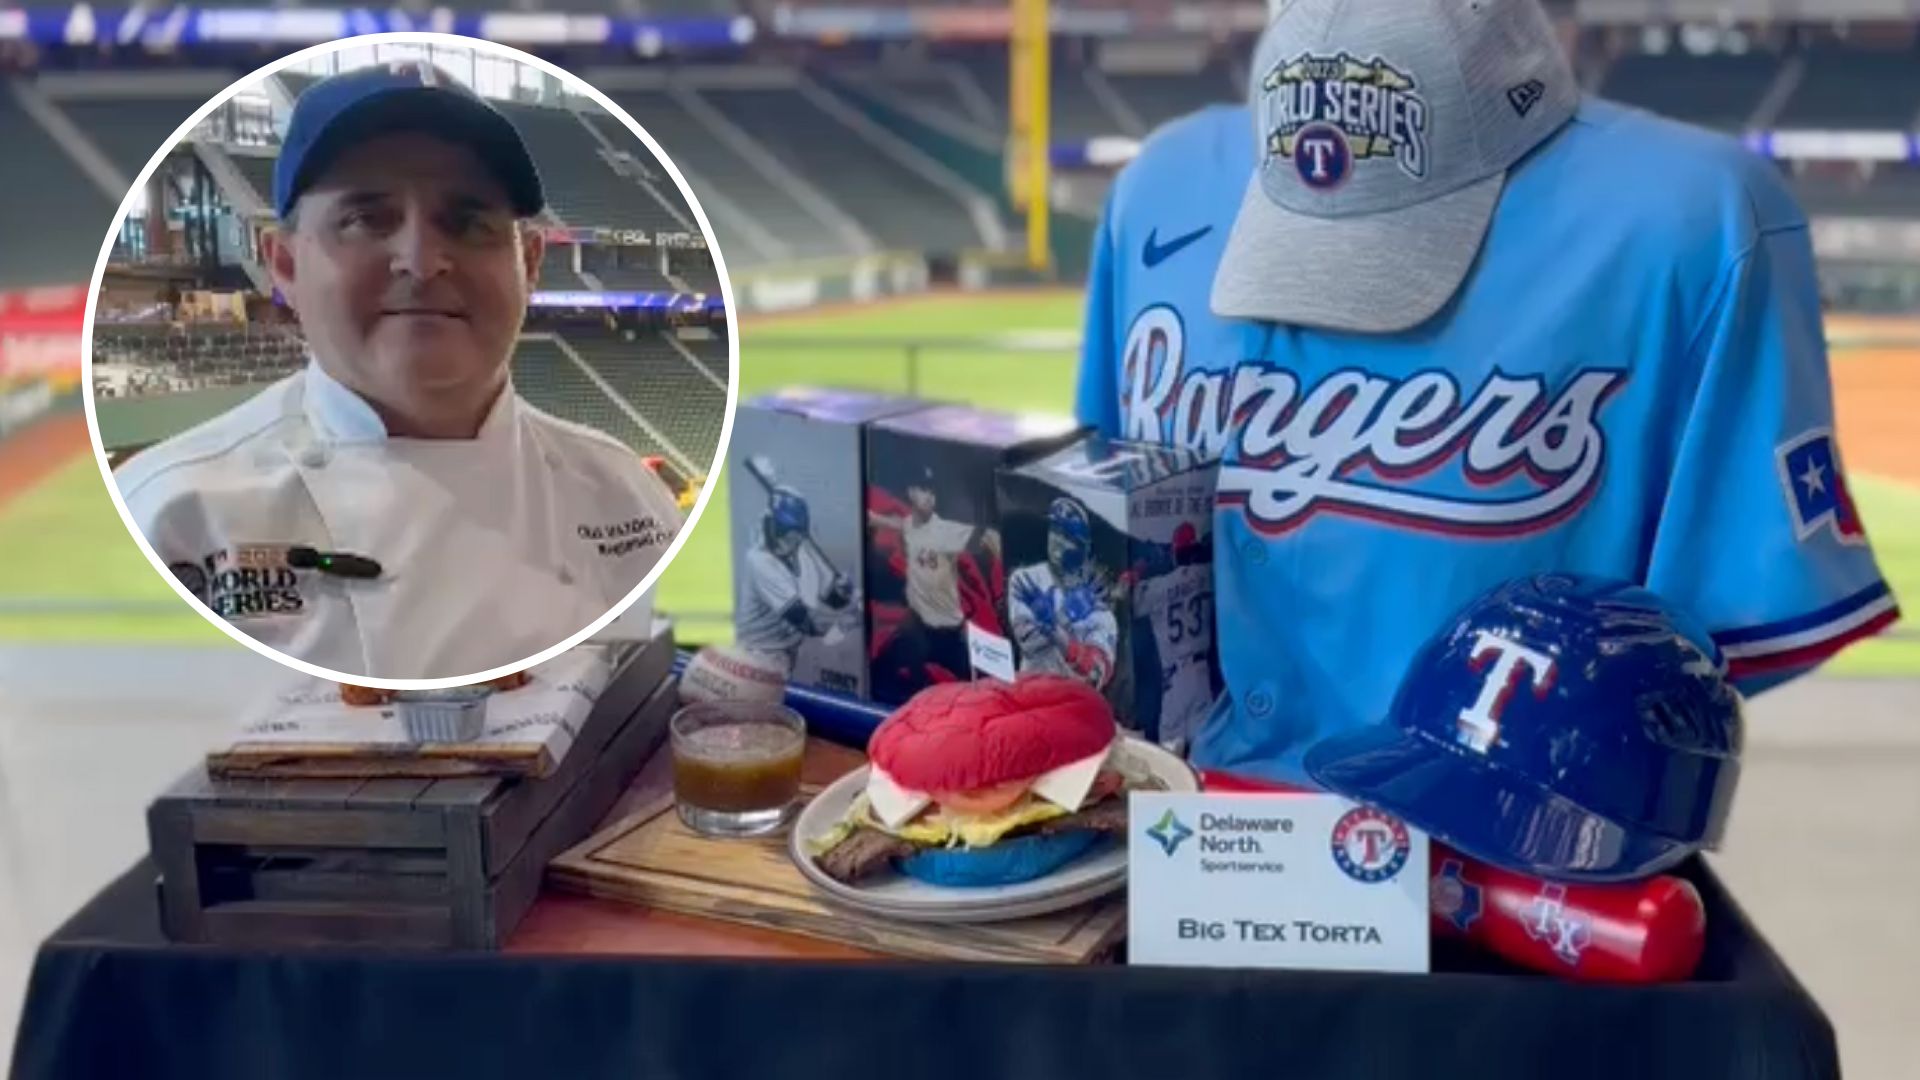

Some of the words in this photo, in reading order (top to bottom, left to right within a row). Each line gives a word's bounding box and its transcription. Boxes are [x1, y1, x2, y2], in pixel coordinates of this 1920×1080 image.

[1326, 80, 1424, 177] SERIES
[1303, 138, 1334, 178] T
[1119, 303, 1627, 538] Rangers
[1167, 598, 1203, 643] 53
[1457, 628, 1557, 753] T
[1200, 813, 1293, 834] Delaware
[1200, 860, 1284, 873] Sportservice
[1356, 829, 1387, 864] T
[1233, 919, 1286, 942] TEX
[1291, 921, 1382, 944] TORTA
